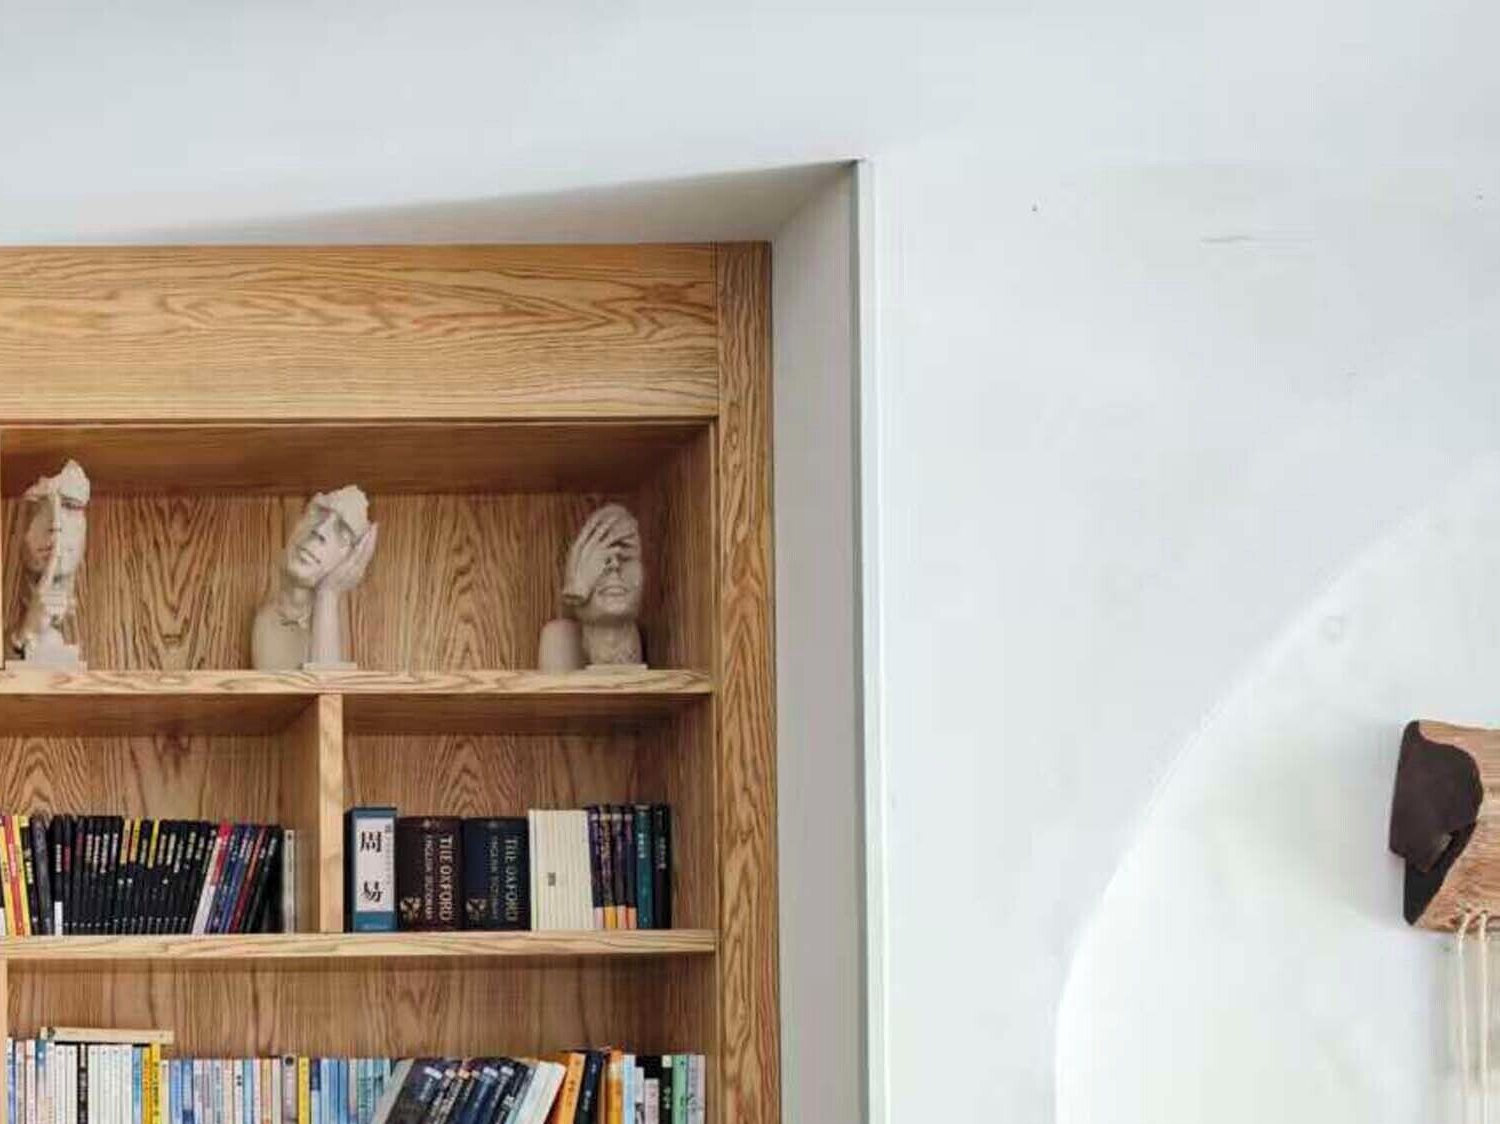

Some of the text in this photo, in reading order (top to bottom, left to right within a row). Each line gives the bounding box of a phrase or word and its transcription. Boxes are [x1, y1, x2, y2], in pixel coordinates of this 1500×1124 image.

[360, 829, 384, 903] 周易
[438, 834, 453, 921] THE OXFORD
[504, 836, 519, 922] THE OXFORD
